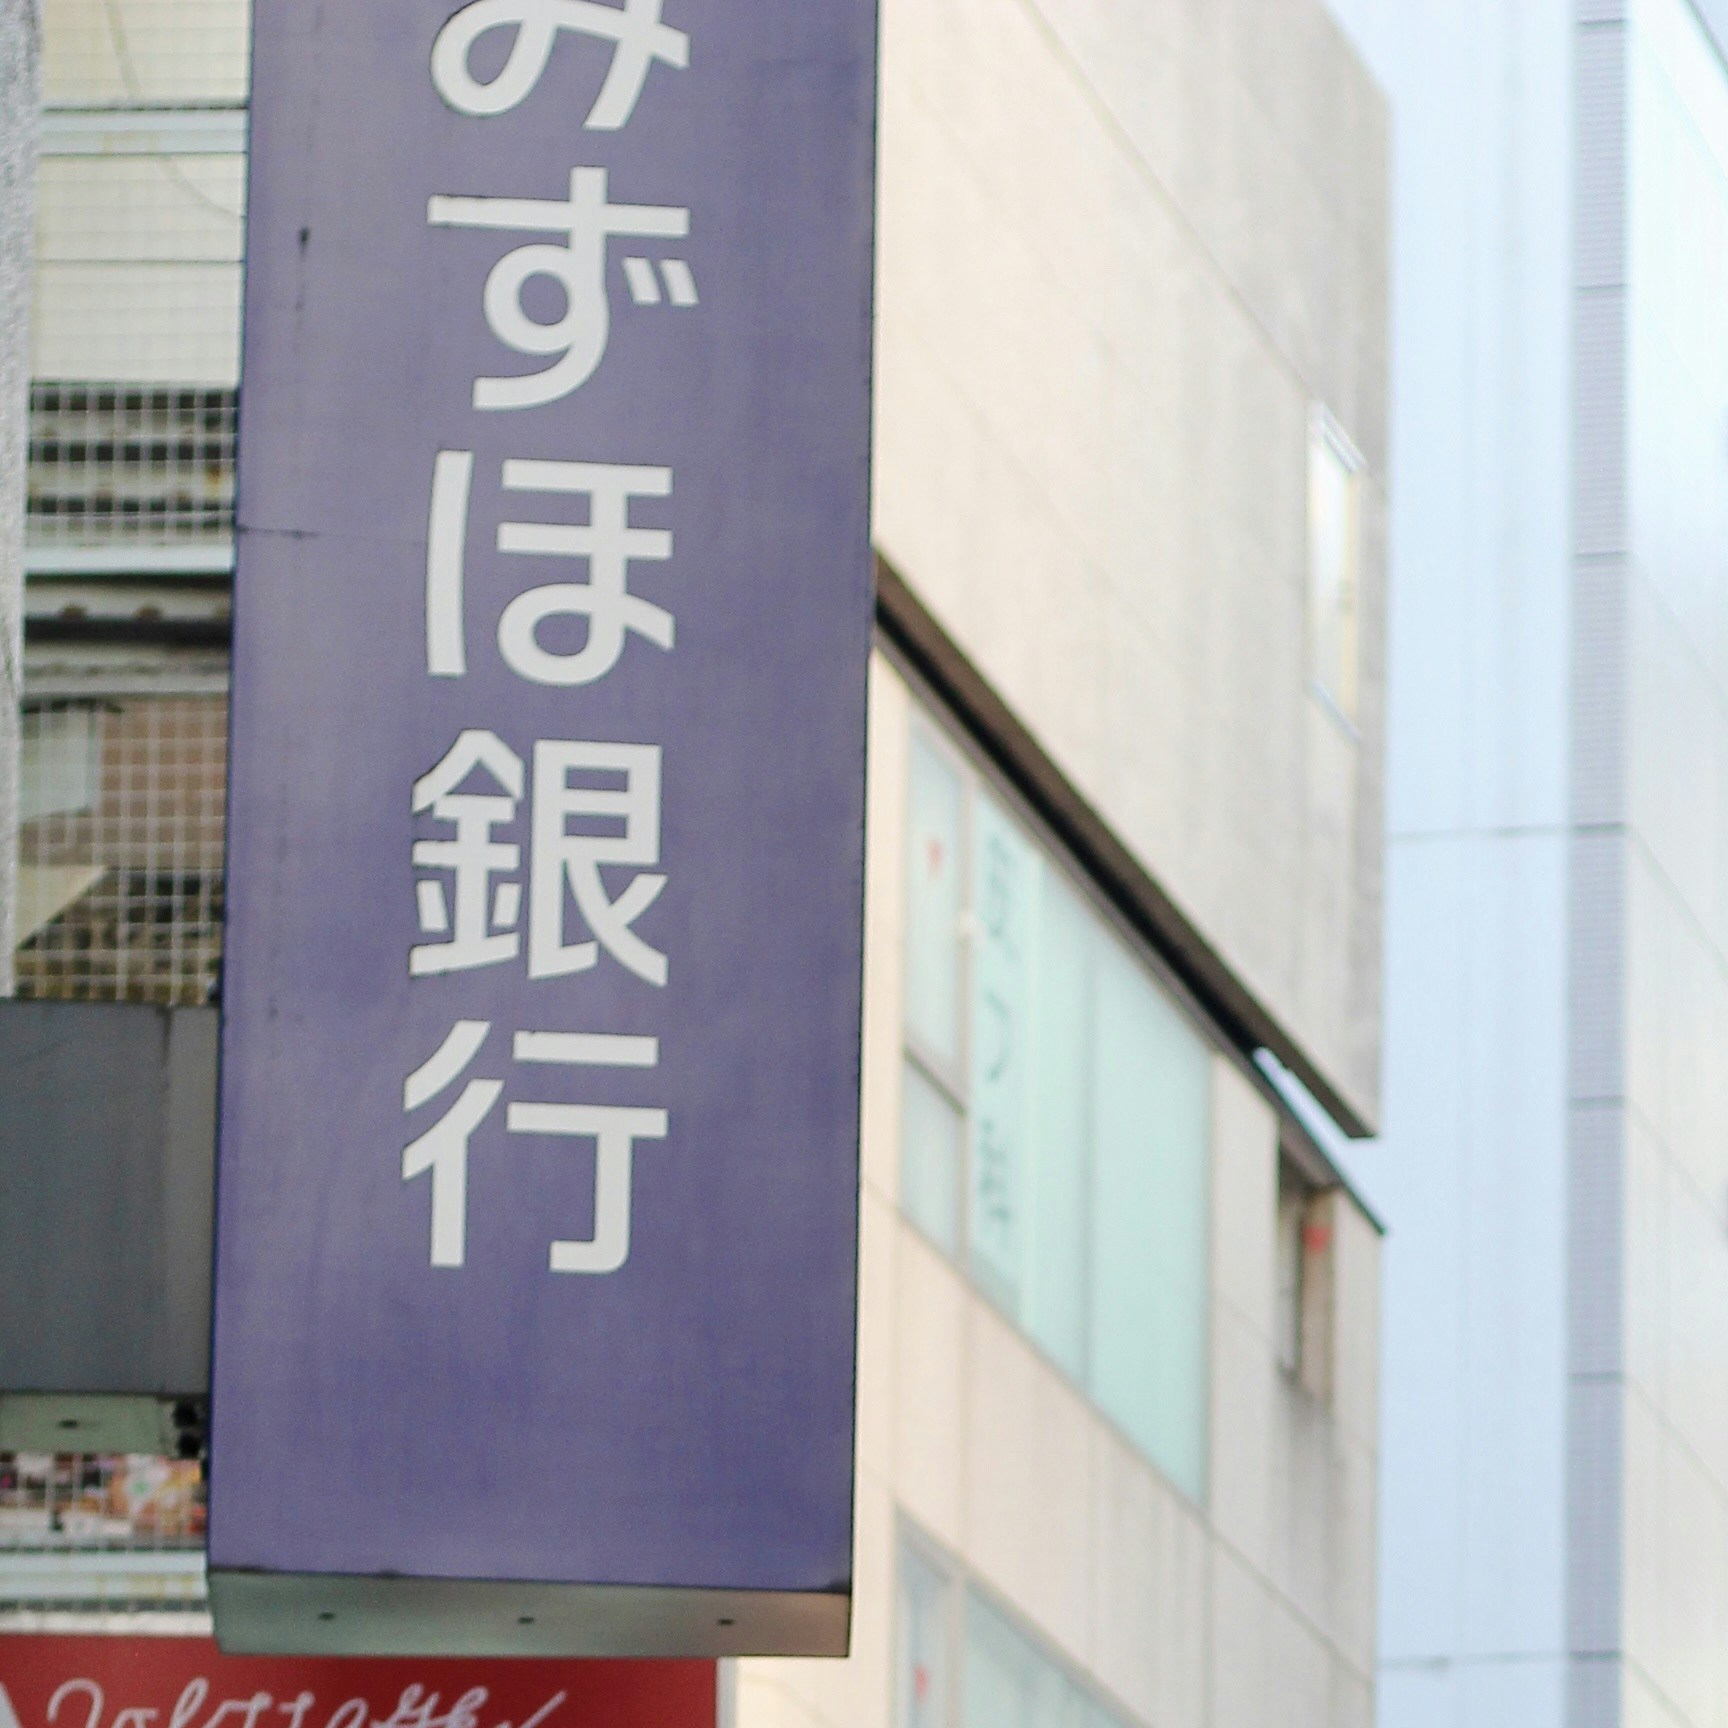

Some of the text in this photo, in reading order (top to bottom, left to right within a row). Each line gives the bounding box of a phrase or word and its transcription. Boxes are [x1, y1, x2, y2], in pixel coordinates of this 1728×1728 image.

[400, 0, 699, 1272] みずほ銀行
